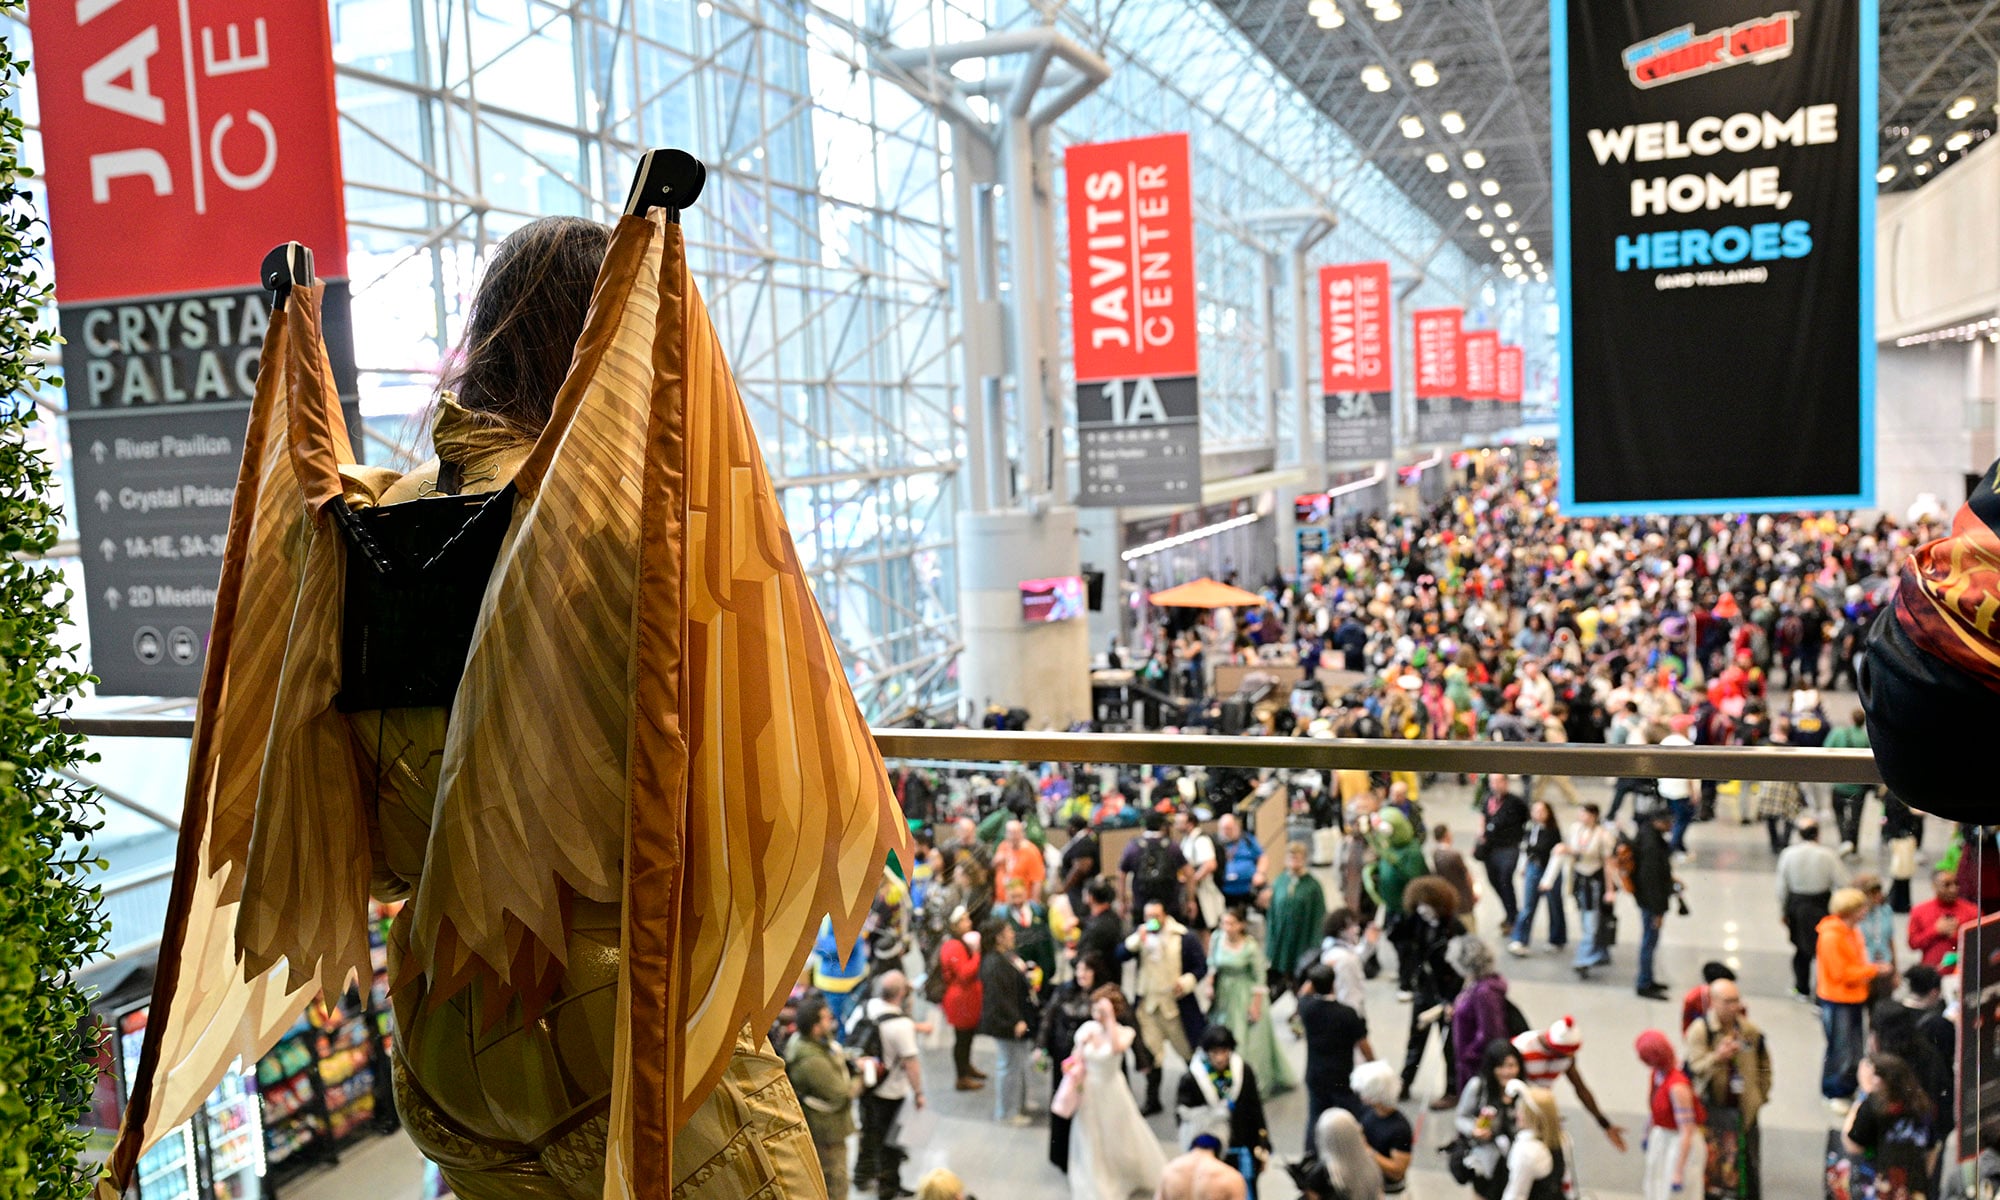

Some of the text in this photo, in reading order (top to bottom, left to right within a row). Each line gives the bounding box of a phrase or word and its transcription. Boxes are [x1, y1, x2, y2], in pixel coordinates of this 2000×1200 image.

[1587, 103, 1839, 165] WELCOME
[1630, 166, 1792, 217] HOME,
[1085, 170, 1130, 349] JAVITS
[1138, 164, 1174, 346] CENTER
[1614, 219, 1813, 272] HEROES
[1329, 279, 1355, 377] JAVITS
[1360, 275, 1381, 376] CENTER
[1101, 377, 1169, 425] 1A
[115, 434, 231, 459] River Pavilion
[119, 486, 181, 513] Crystal
